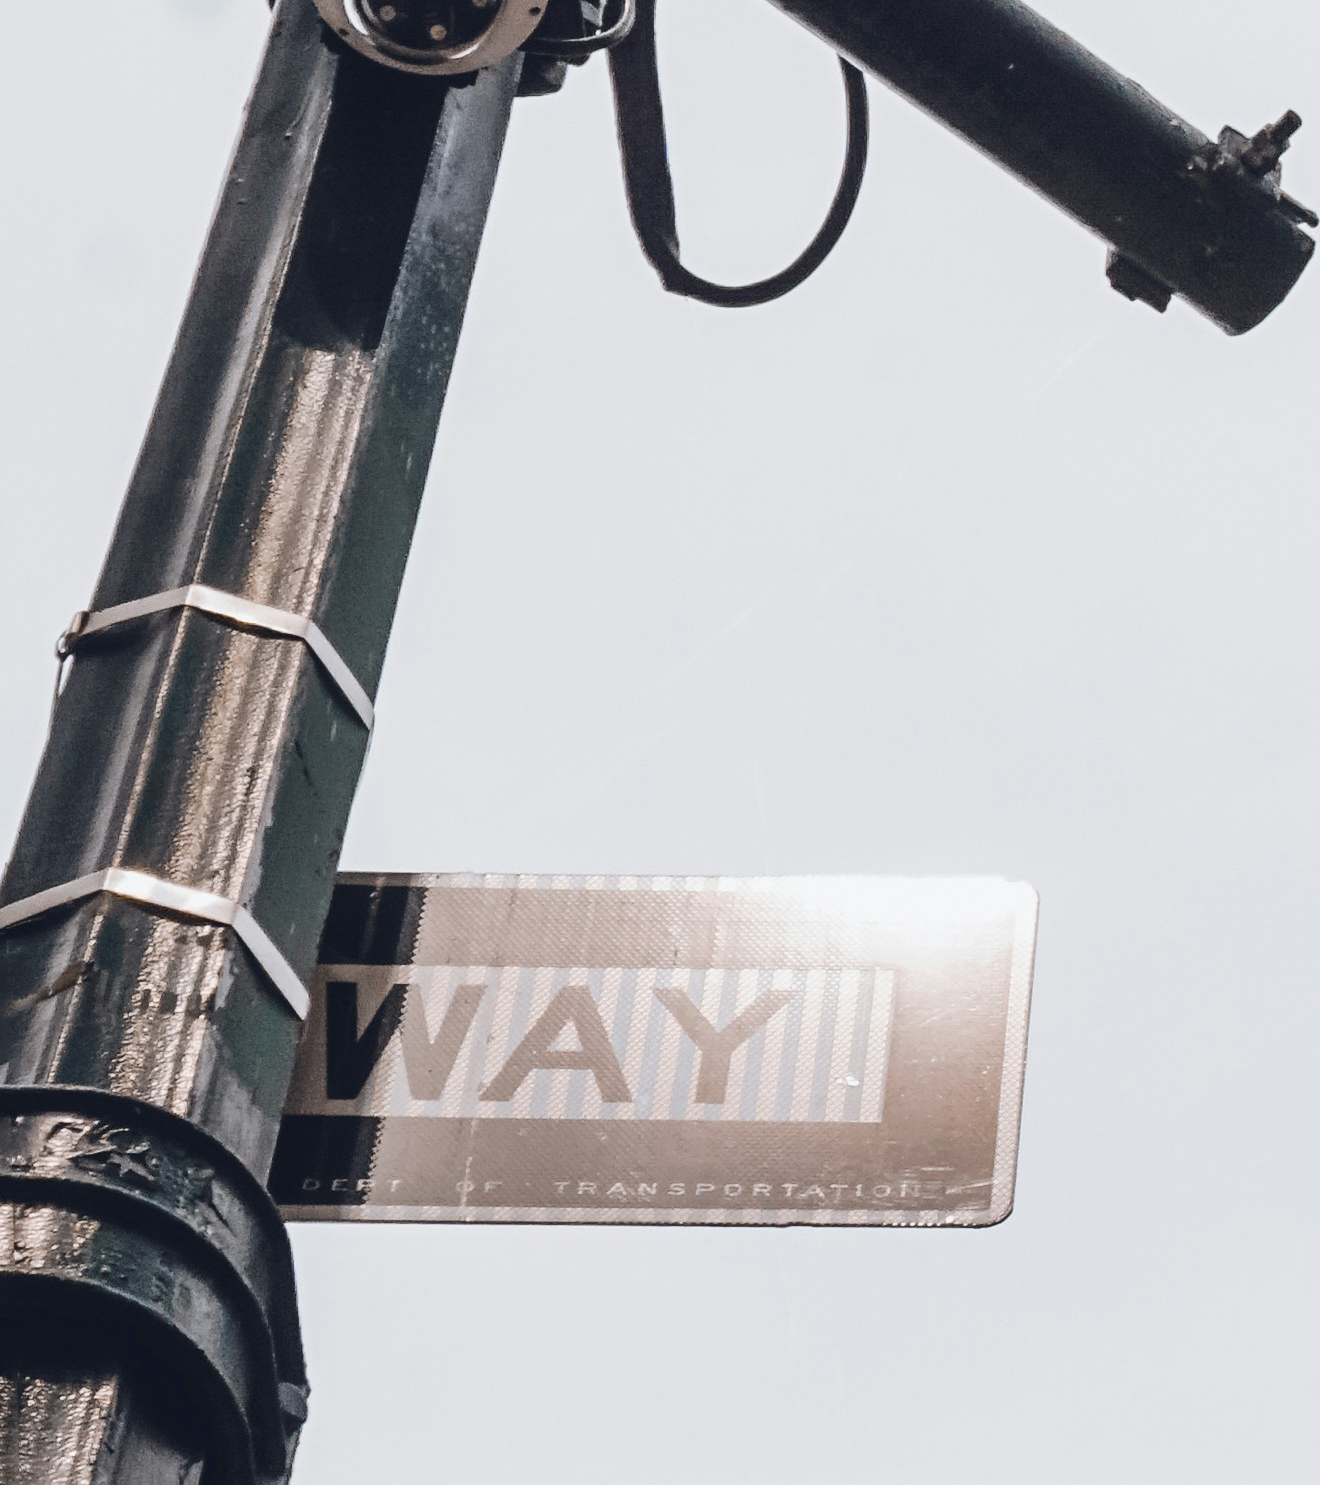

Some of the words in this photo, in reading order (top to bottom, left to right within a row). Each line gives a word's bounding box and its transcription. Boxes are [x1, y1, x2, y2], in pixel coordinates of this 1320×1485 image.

[326, 980, 805, 1105] WAY
[301, 1178, 402, 1193] DEPT
[455, 1180, 502, 1194] OF
[553, 1181, 923, 1198] TRANSPORTATION
